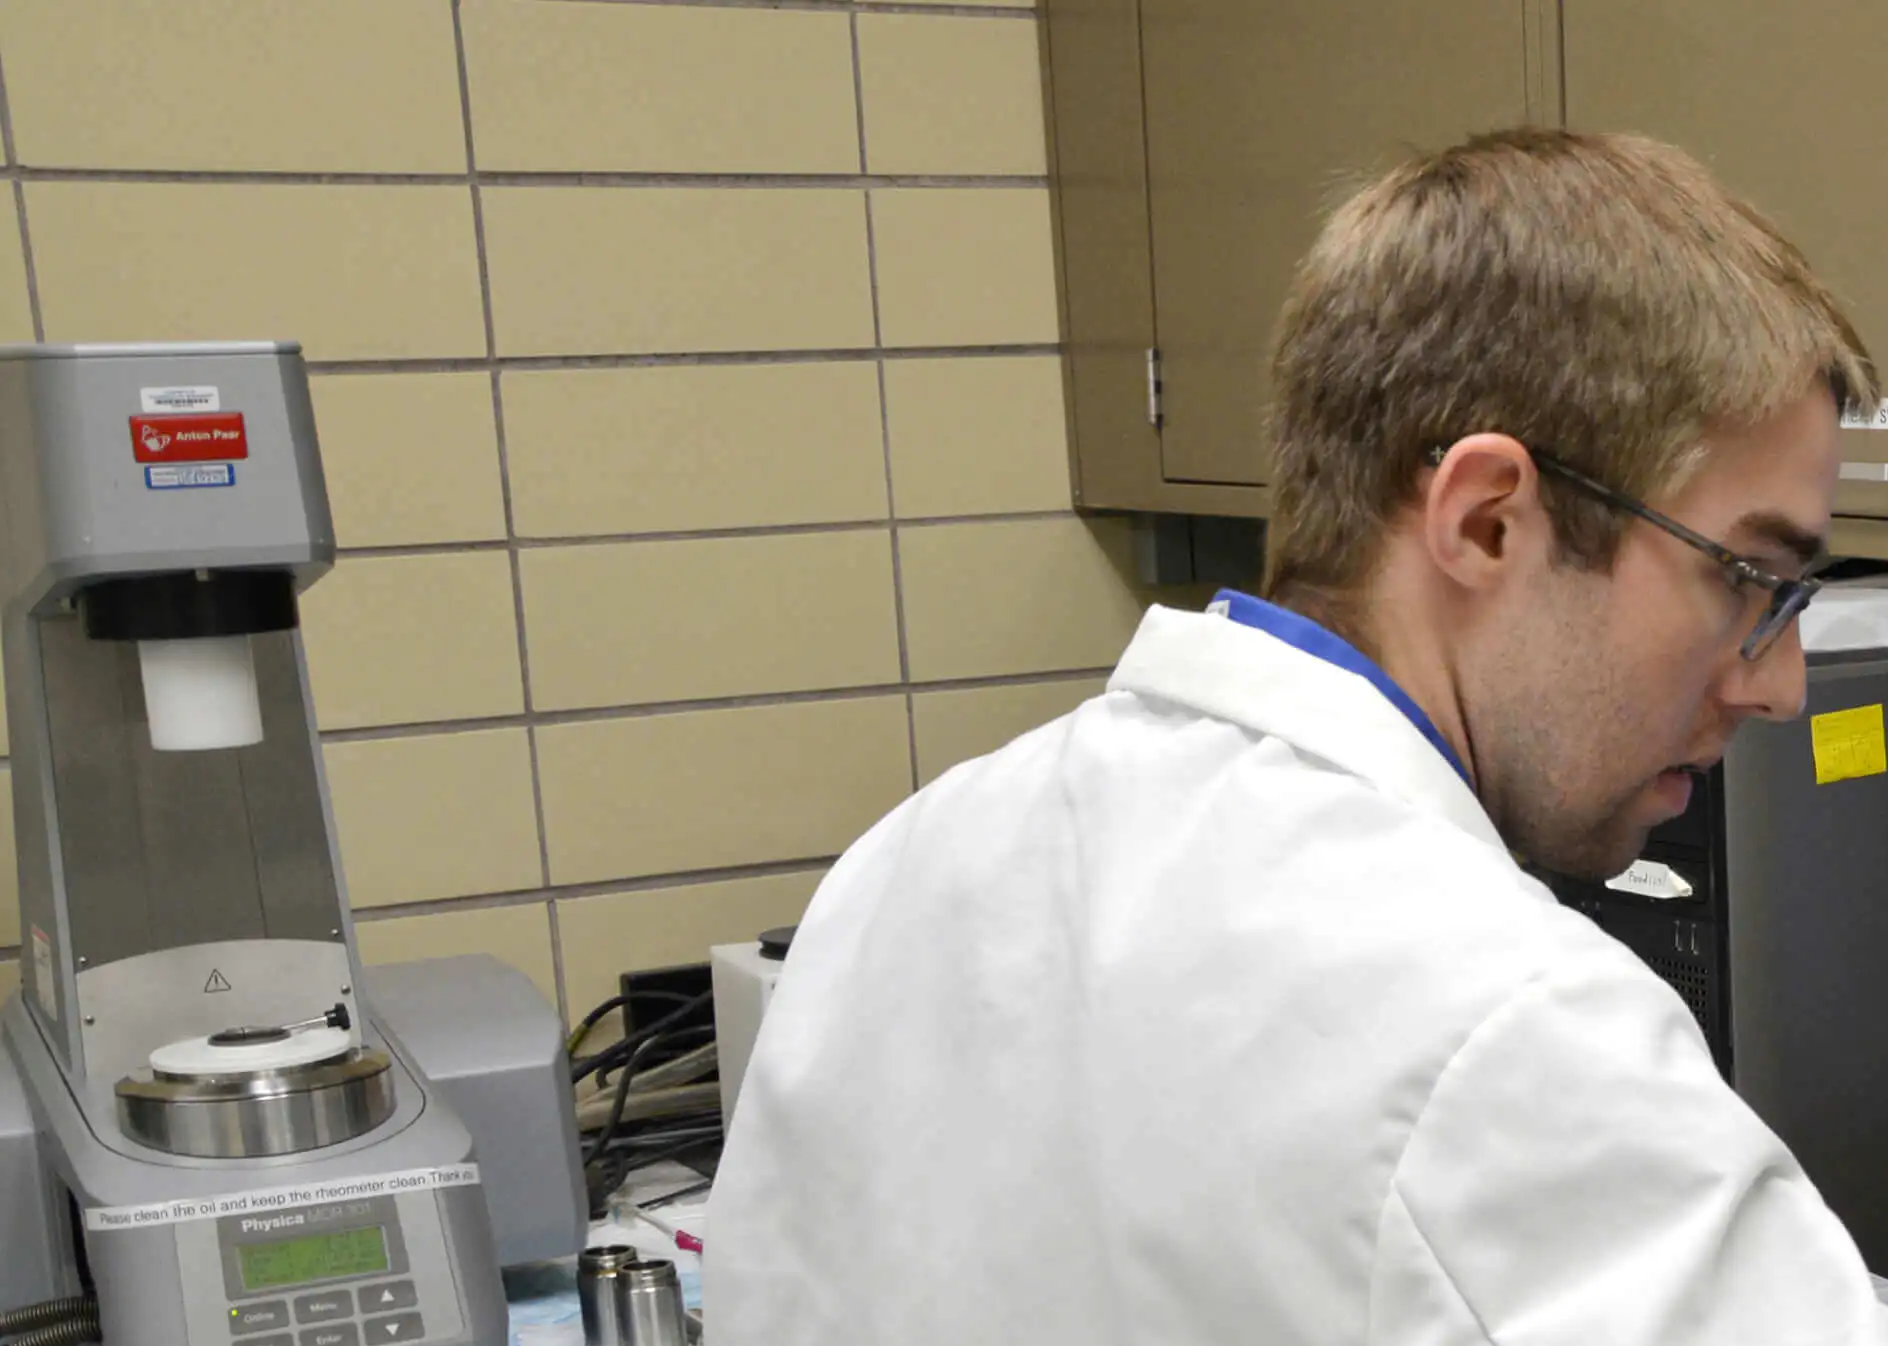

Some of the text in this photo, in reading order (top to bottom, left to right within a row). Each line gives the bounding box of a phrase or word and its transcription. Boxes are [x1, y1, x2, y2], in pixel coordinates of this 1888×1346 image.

[100, 1212, 131, 1225] Please
[134, 1209, 168, 1223] clean
[173, 1204, 196, 1218] the
[200, 1200, 216, 1215] oil
[220, 1197, 247, 1211] and
[251, 1193, 286, 1210] keep
[289, 1189, 312, 1202] the
[315, 1180, 385, 1200] rheometer
[241, 1214, 305, 1233] Physica
